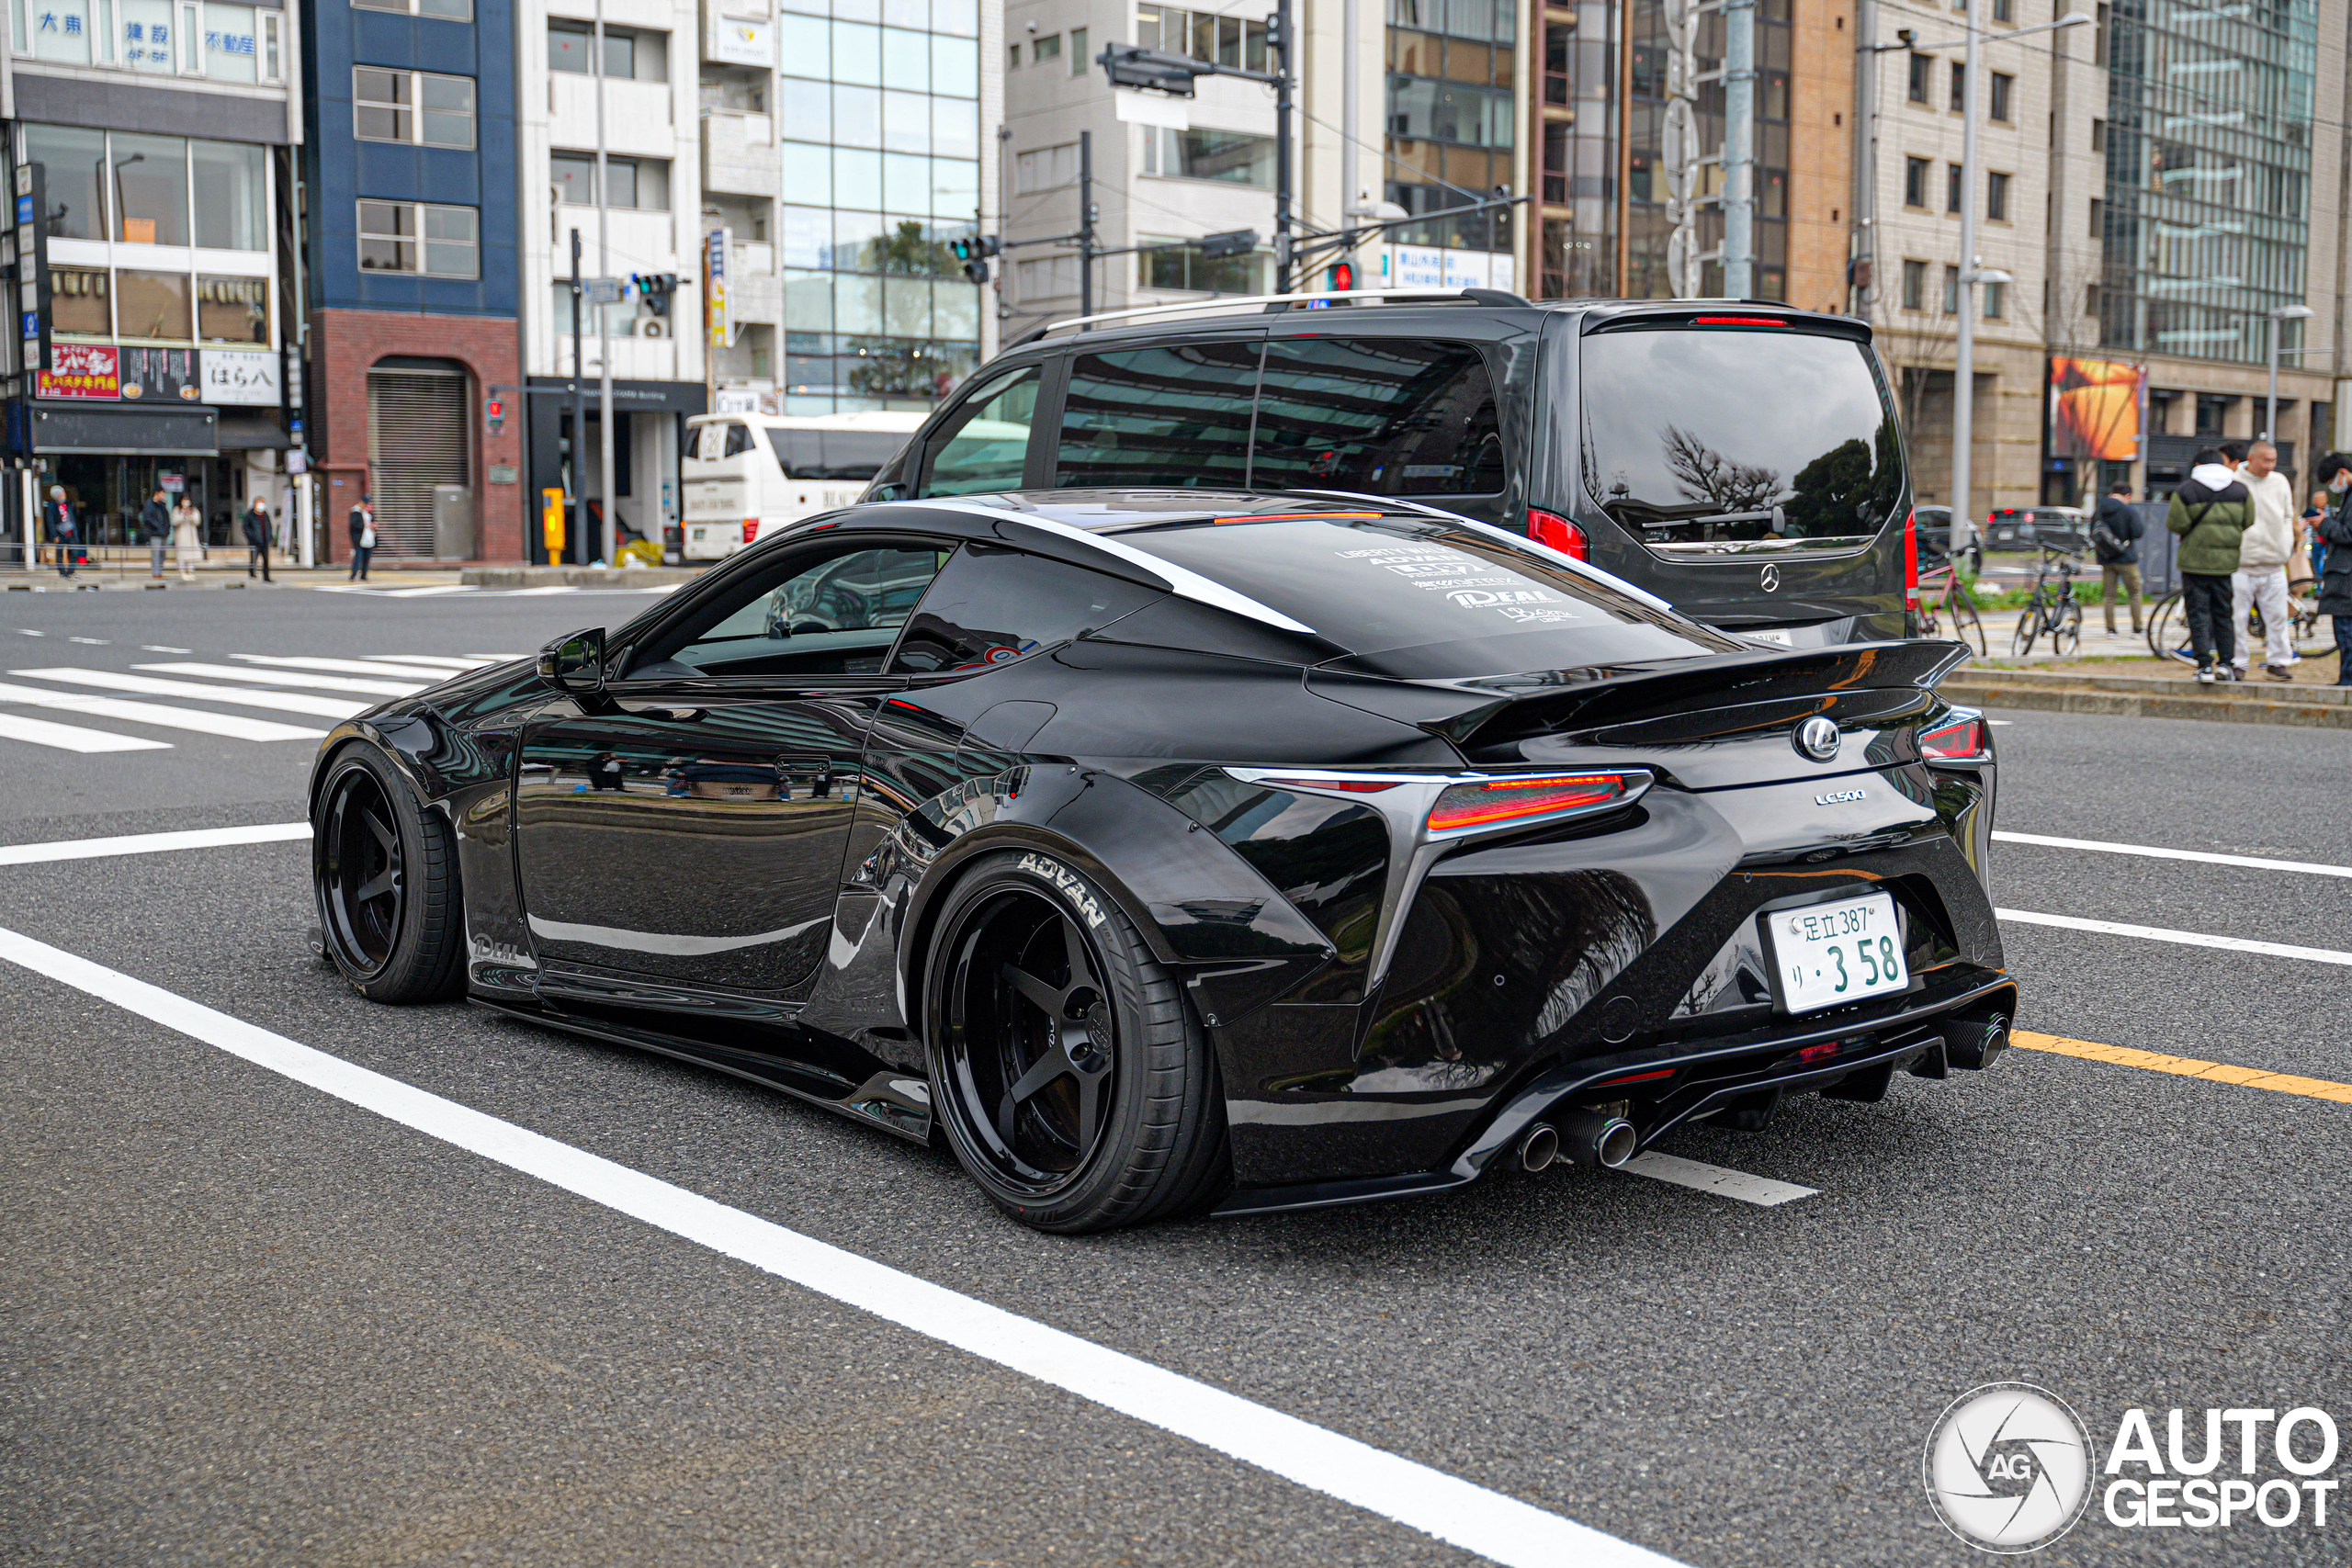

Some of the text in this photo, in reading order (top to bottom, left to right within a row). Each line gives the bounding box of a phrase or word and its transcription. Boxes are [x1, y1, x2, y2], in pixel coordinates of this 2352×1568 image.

[40, 11, 255, 56] 大東 建設 不動産
[40, 373, 118, 391] 生パスタ専門店
[211, 365, 274, 389] はら八
[1334, 547, 1456, 558] LIBERTY WALK
[1369, 555, 1464, 565] ADVAN
[1445, 590, 1554, 607] IDEAL
[1815, 789, 1867, 806] LC500
[1016, 852, 1107, 930] ADVAN
[1804, 908, 1867, 942] 足立 387
[473, 932, 518, 961] IDEAL
